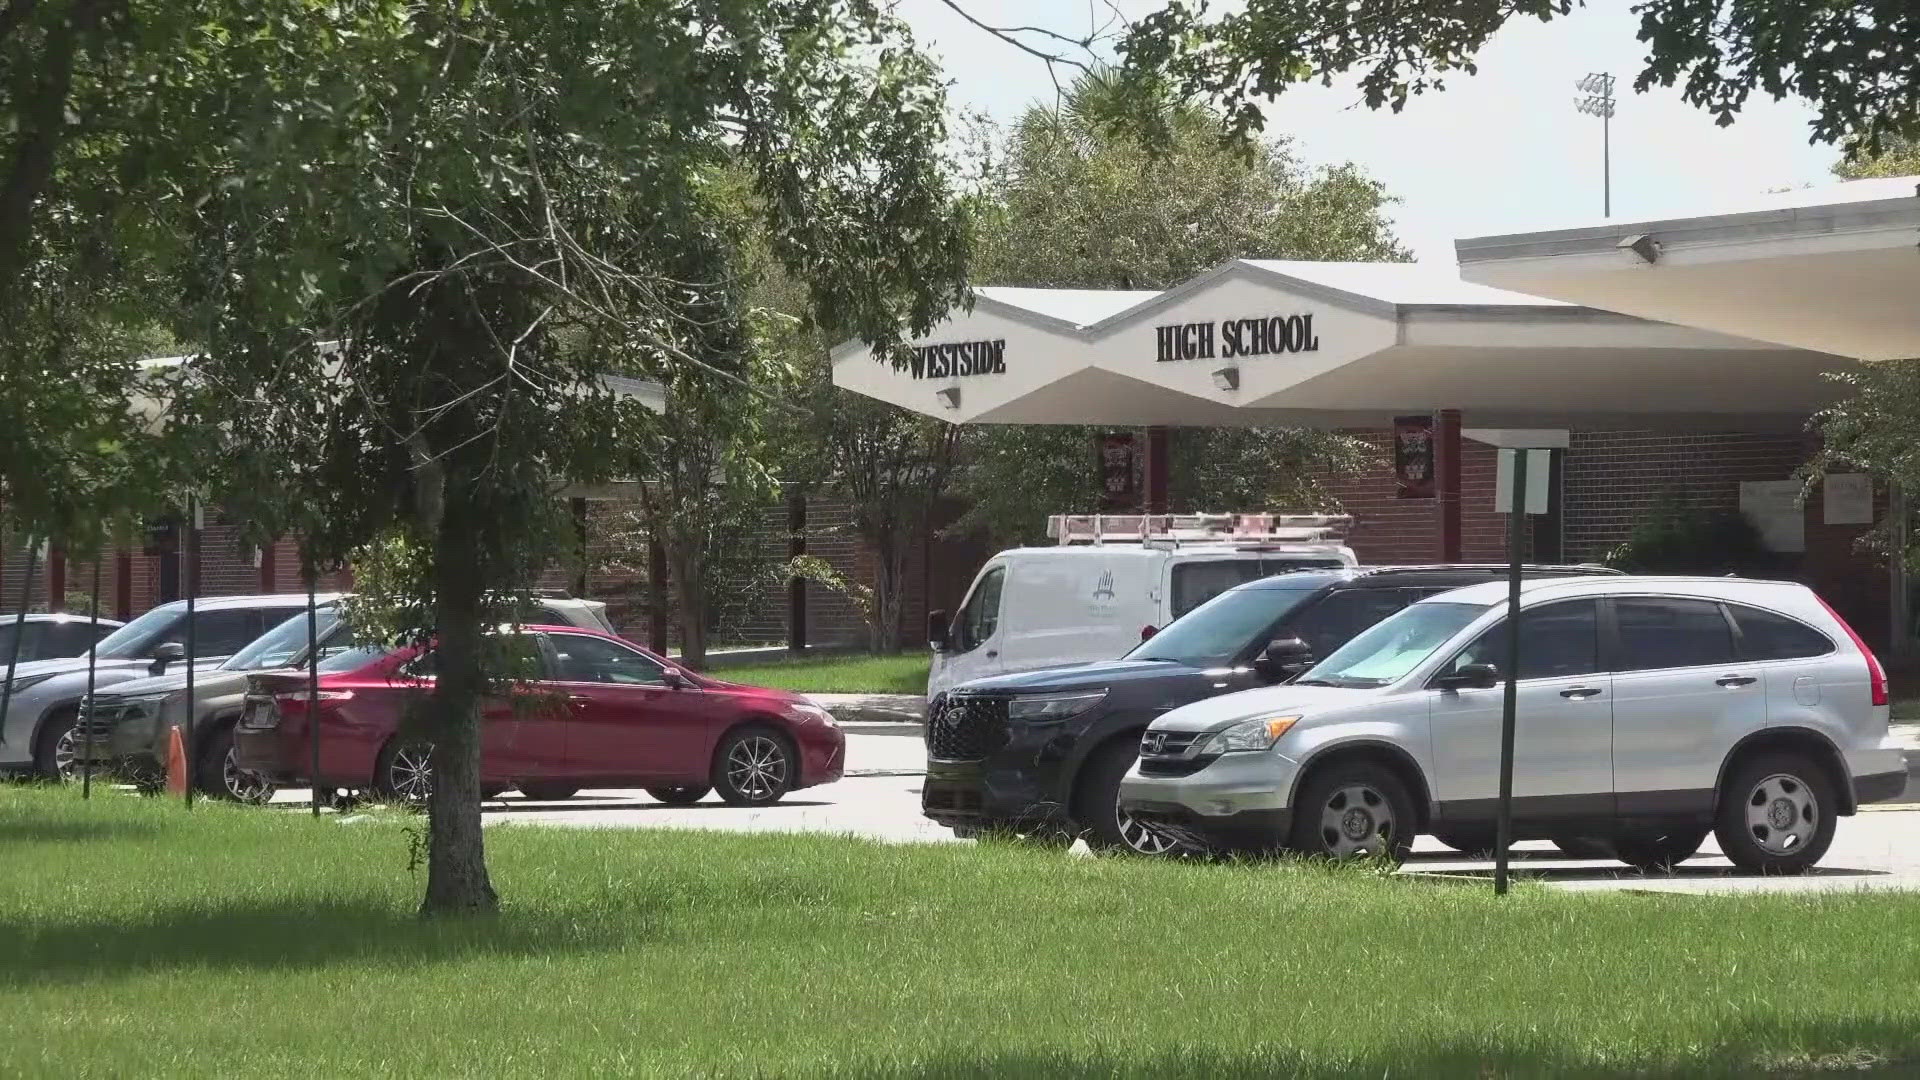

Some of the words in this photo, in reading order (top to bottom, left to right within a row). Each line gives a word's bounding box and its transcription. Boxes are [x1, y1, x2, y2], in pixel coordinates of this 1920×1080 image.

[911, 339, 1006, 380] WESTSIDE
[1156, 321, 1216, 362] HIGH
[1221, 314, 1319, 359] SCHOOL
